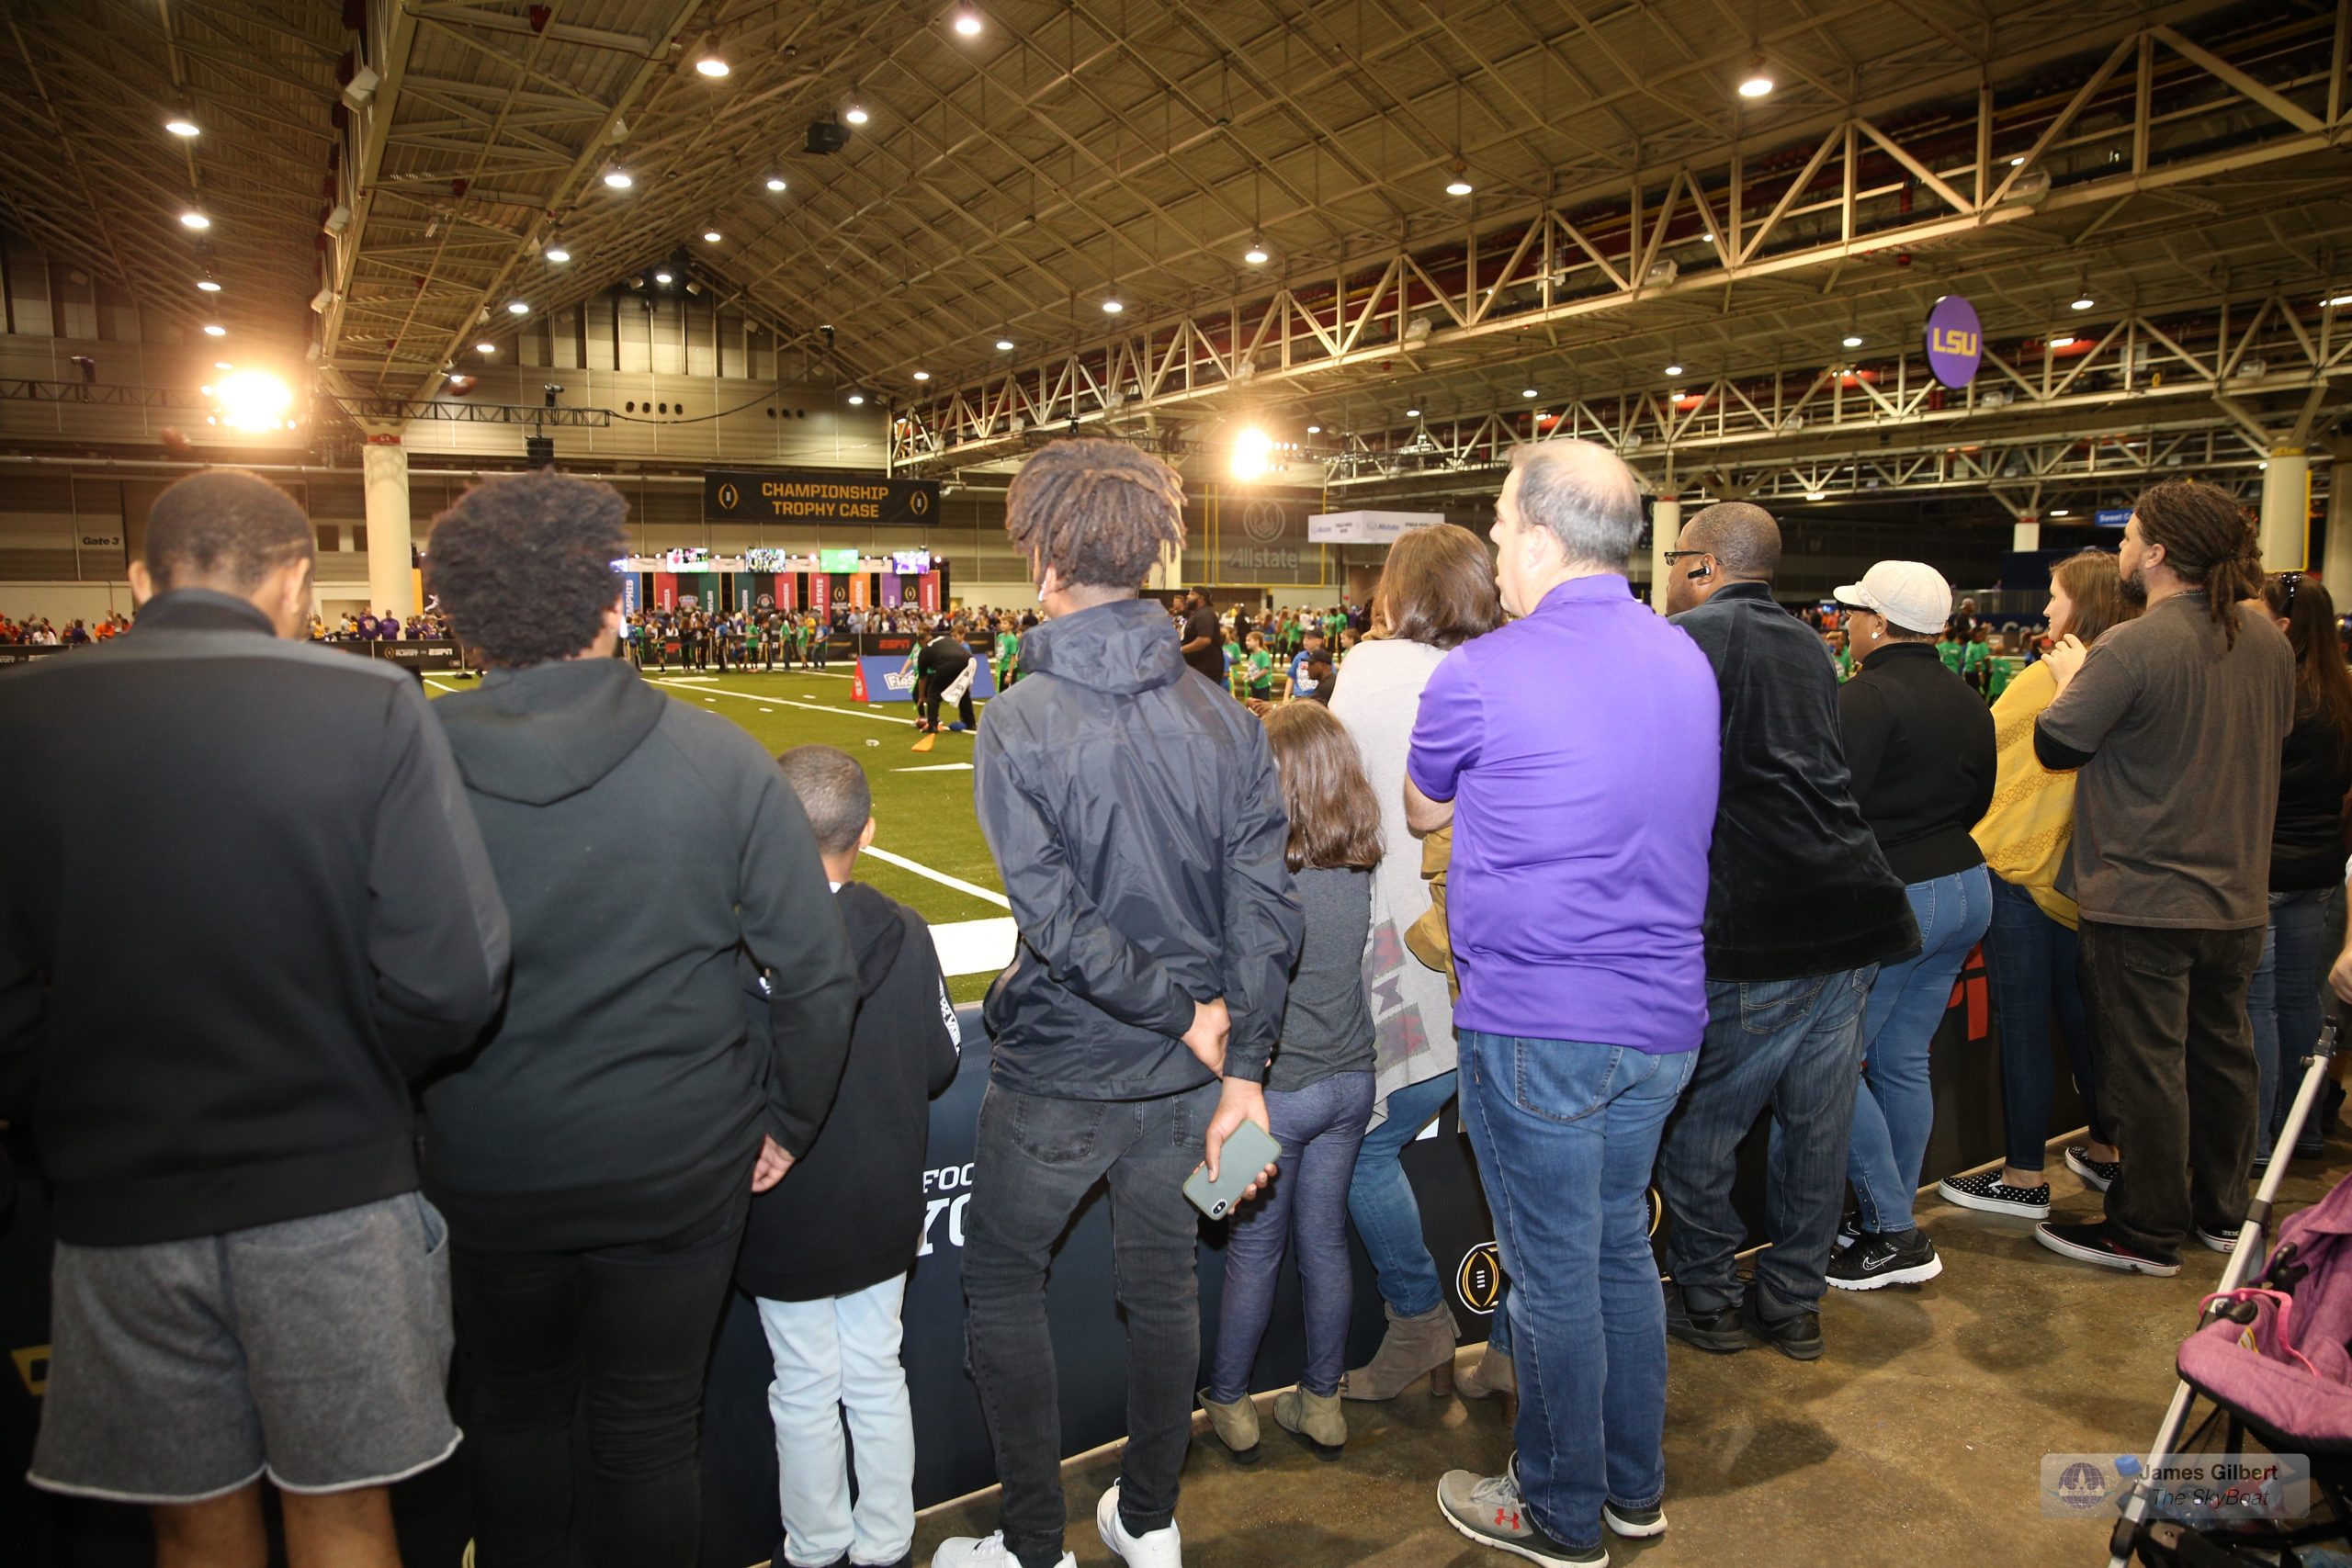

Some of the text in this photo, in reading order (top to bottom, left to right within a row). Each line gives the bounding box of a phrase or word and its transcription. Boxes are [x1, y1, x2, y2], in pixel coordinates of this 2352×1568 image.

[1933, 327, 1978, 357] LSU
[762, 482, 888, 500] CHAMPIONSHIP
[773, 501, 879, 518] TROPHY CASE
[83, 536, 119, 546] Gate 3
[1229, 547, 1298, 569] Allstate
[626, 580, 634, 617] EMPHIS
[428, 648, 453, 656] ESPN
[879, 638, 910, 649] ESPN
